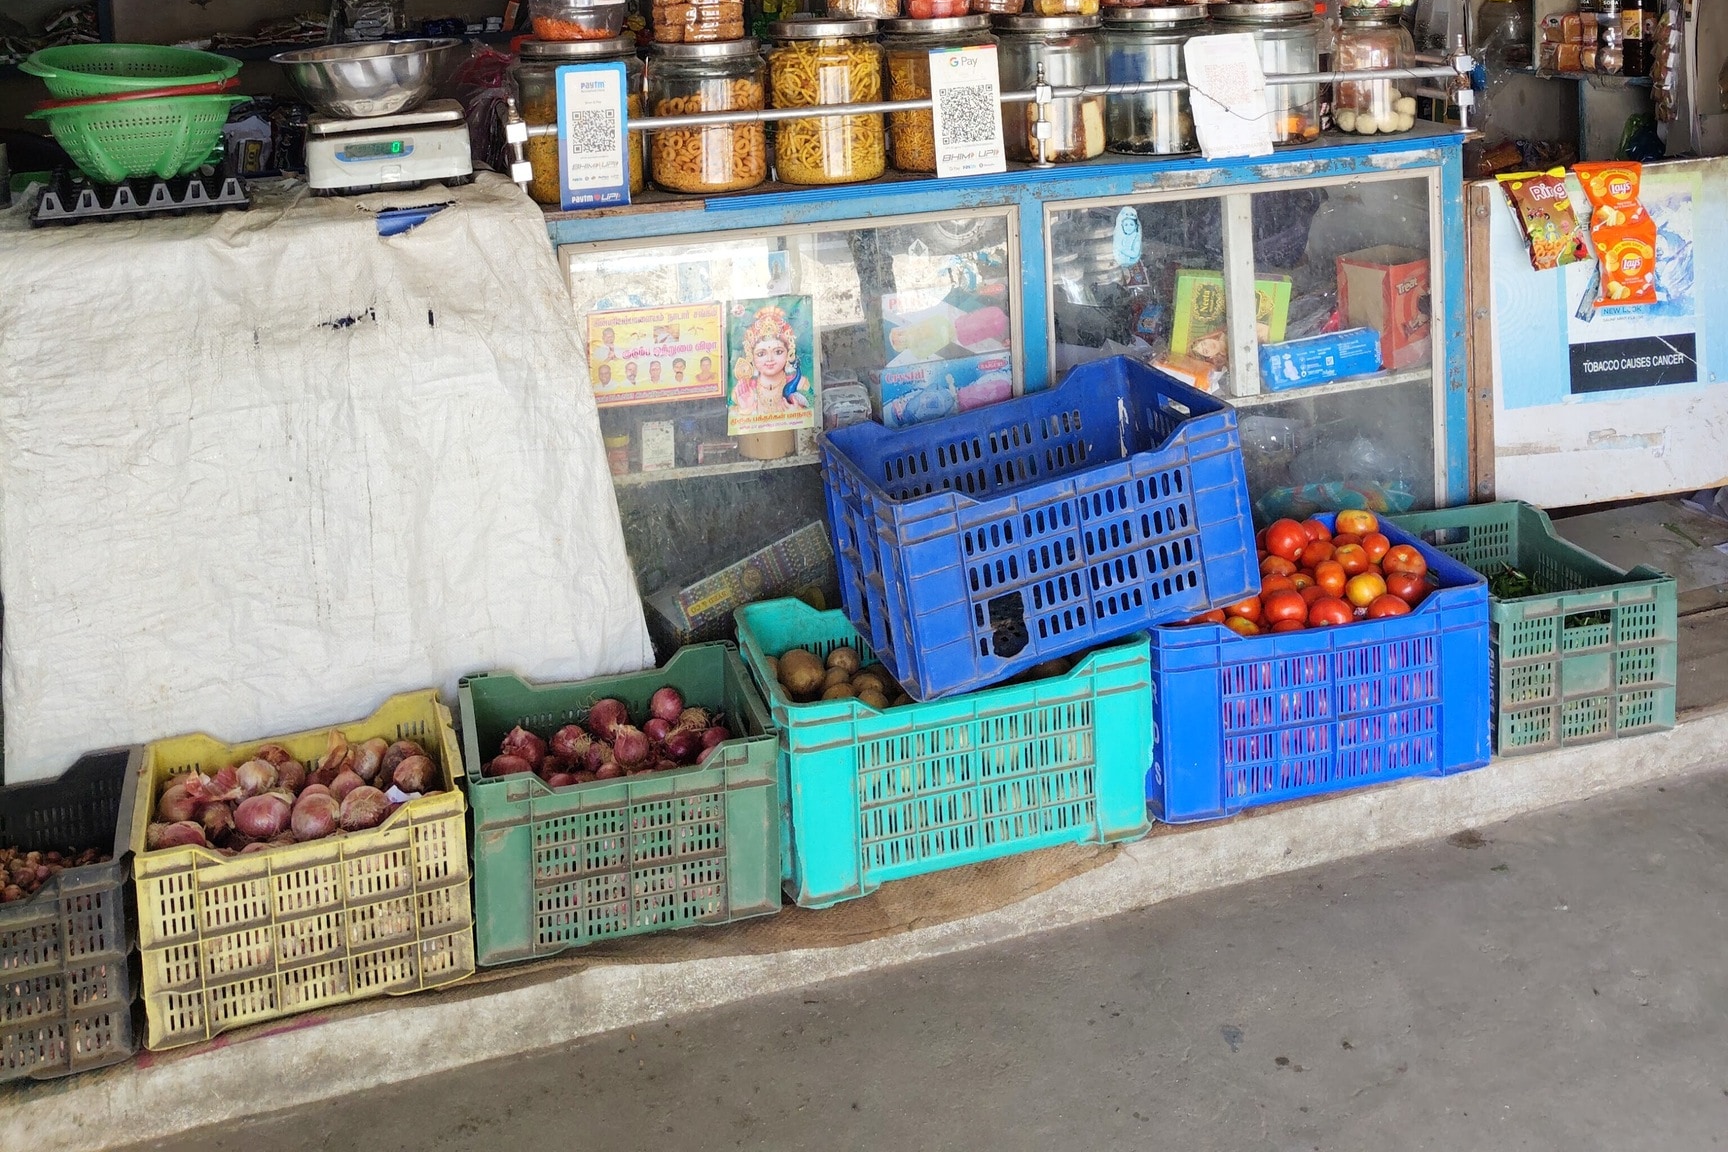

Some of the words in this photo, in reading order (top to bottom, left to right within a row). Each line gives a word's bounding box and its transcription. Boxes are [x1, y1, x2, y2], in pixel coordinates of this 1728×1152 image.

[950, 57, 959, 67] G
[961, 56, 978, 67] Pay
[391, 141, 400, 153] 0
[942, 154, 970, 162] BHIM
[1395, 278, 1418, 295] Treat
[1582, 359, 1620, 373] TOBACCO
[1620, 356, 1651, 369] CAUSES
[1652, 354, 1684, 365] CANCER
